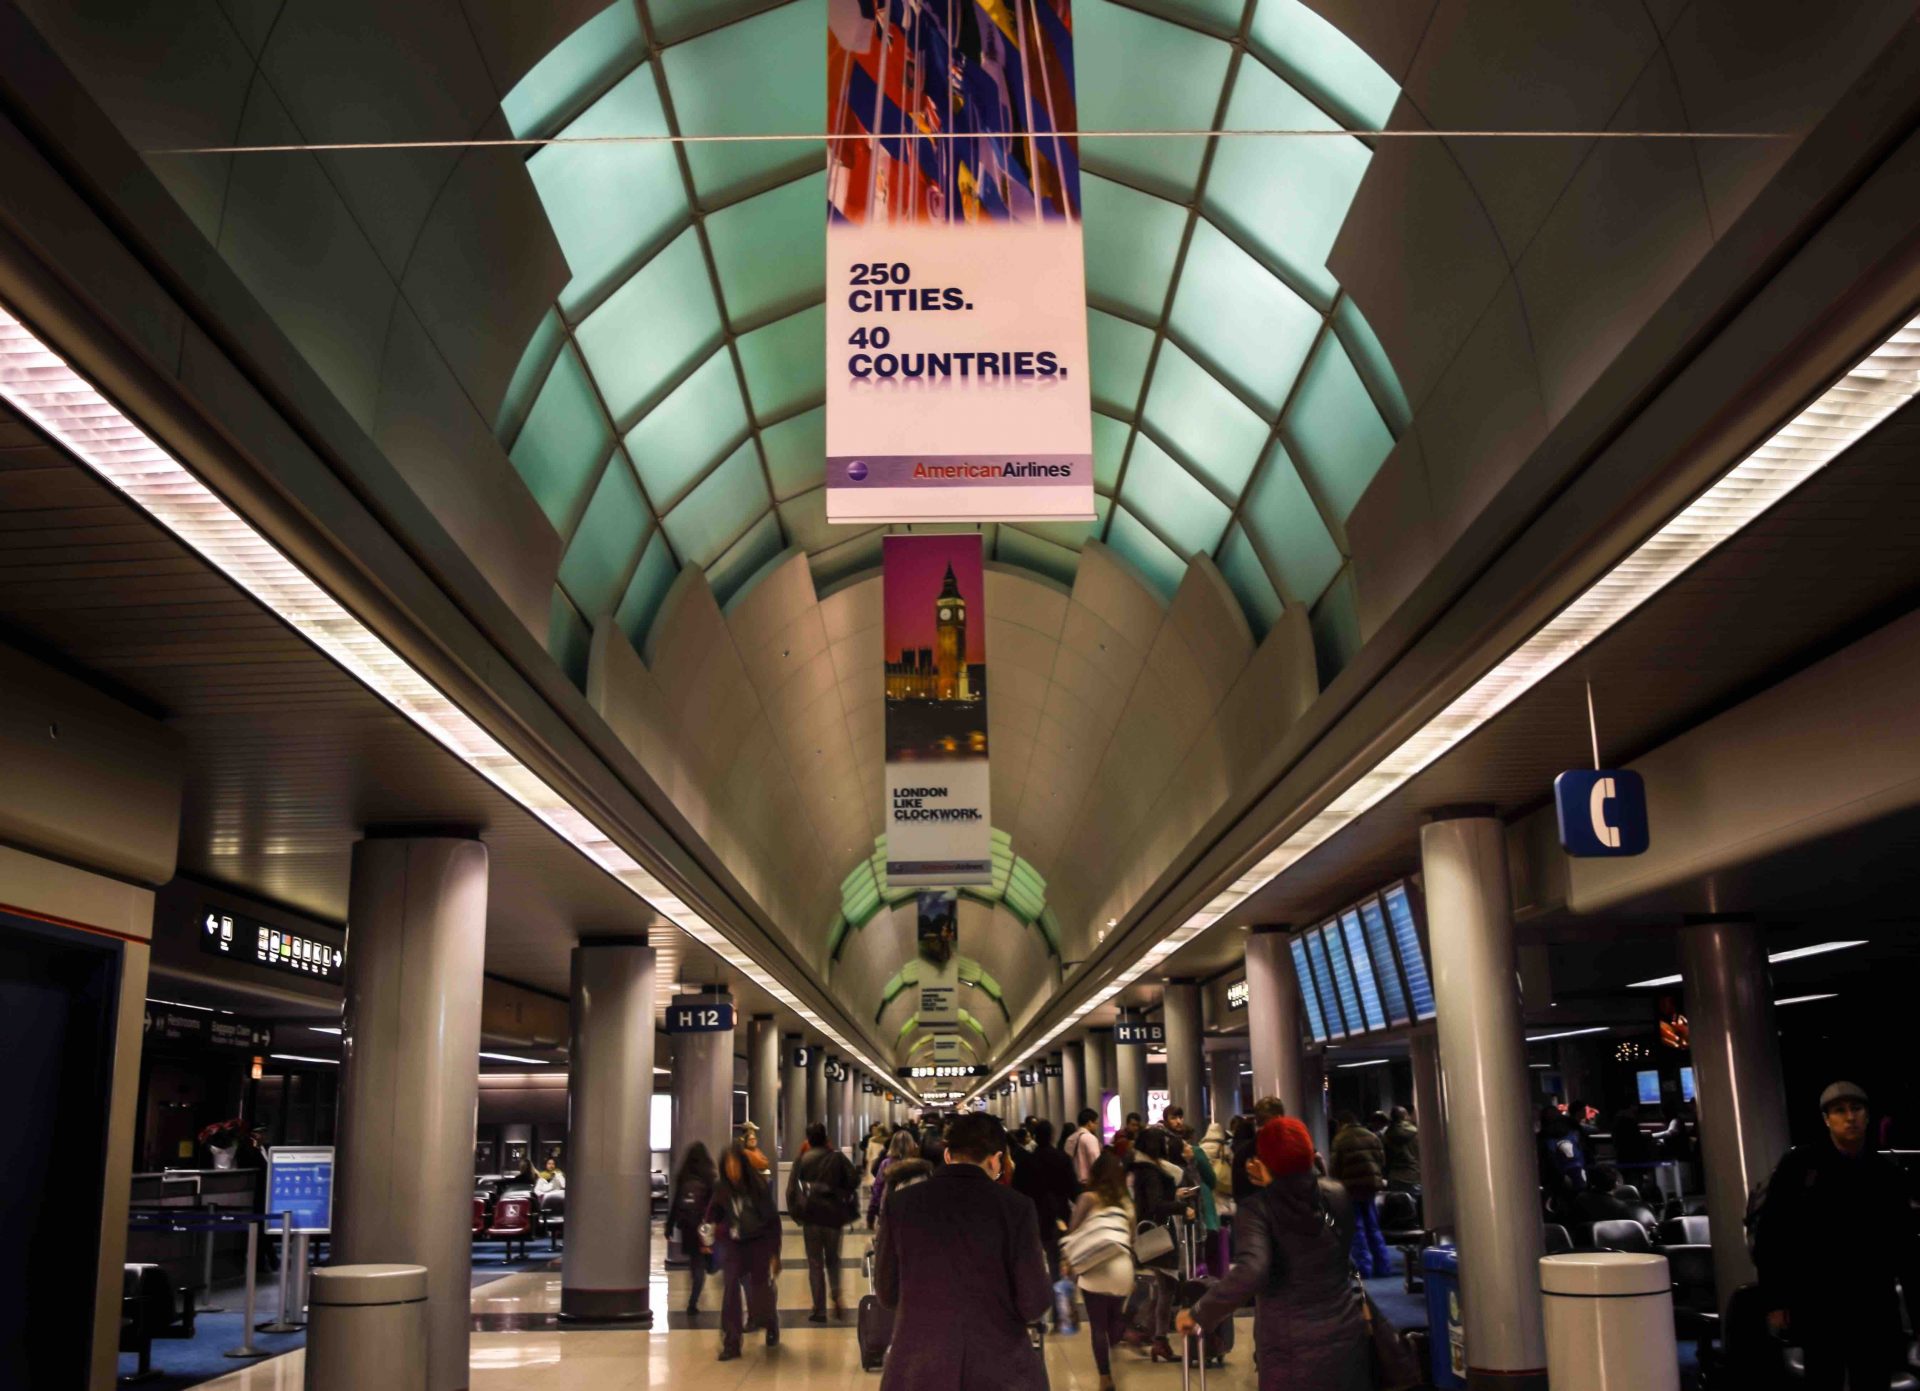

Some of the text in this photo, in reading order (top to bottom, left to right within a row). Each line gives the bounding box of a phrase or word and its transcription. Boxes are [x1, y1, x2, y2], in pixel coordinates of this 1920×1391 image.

[849, 262, 911, 286] 250
[848, 287, 974, 313] CITIES.
[848, 326, 891, 349] 40
[848, 351, 1068, 378] COUNTRIES.
[893, 787, 948, 798] LONDON
[893, 798, 923, 809] LIKE
[894, 808, 983, 820] CLOCKWORK.
[679, 1010, 720, 1027] H 12
[1119, 1027, 1163, 1039] H 11 B
